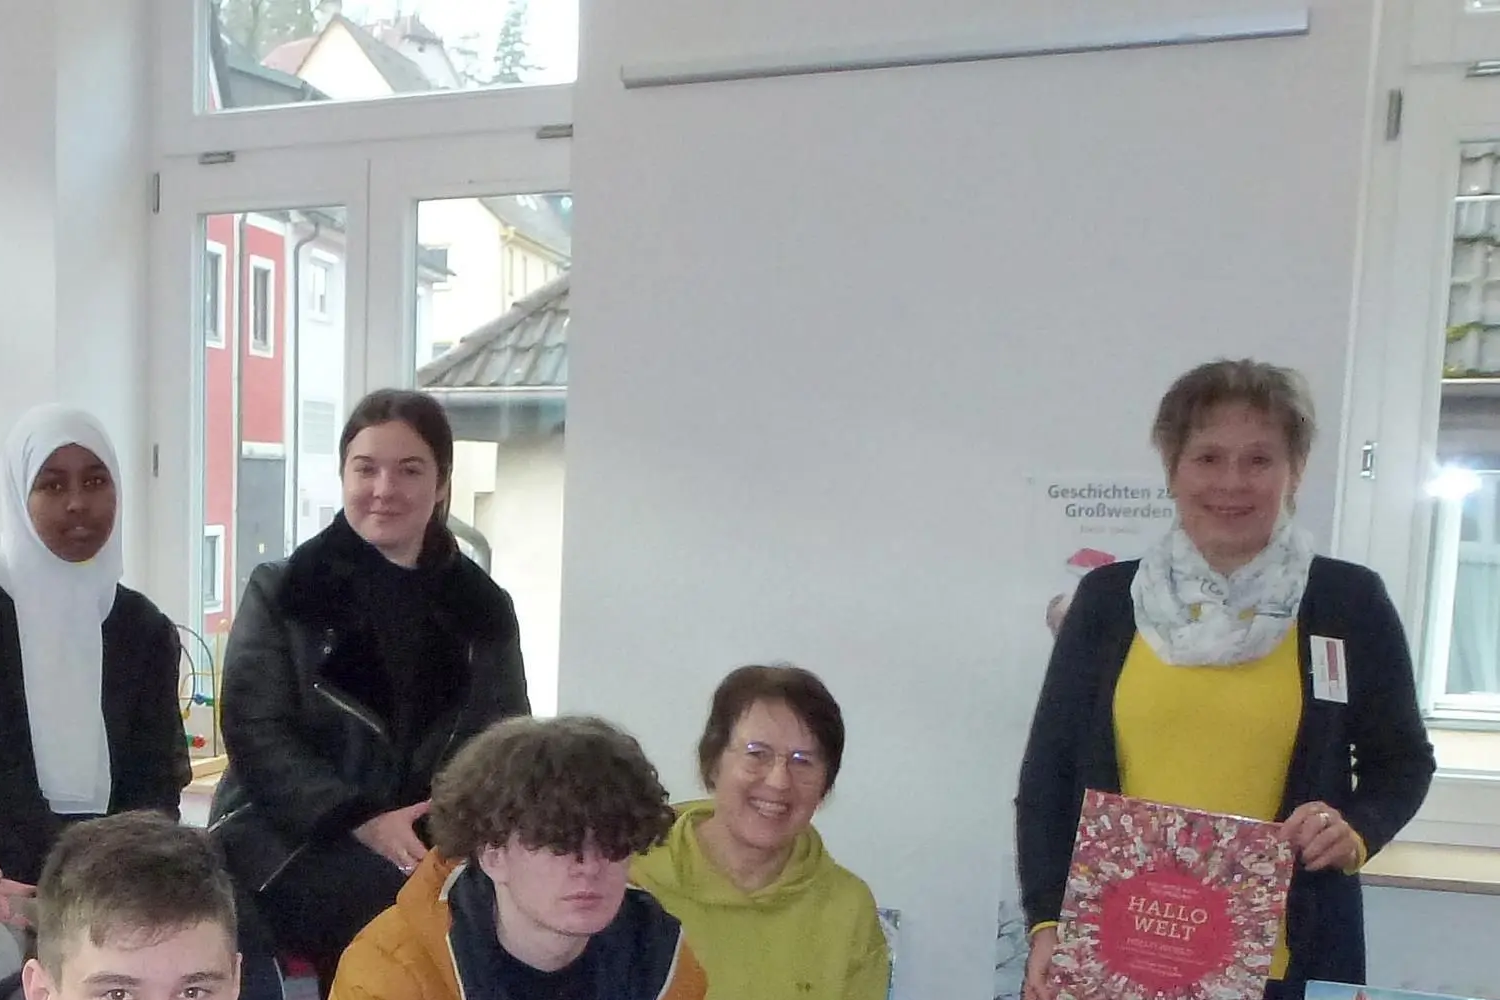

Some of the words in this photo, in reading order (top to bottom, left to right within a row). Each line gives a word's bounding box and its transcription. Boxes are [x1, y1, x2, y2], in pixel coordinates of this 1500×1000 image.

[1047, 483, 1151, 499] Geschichten
[1156, 487, 1173, 500] zu
[1065, 503, 1173, 518] Großwerden
[1128, 896, 1208, 924] HALLO
[1134, 915, 1196, 941] WELT
